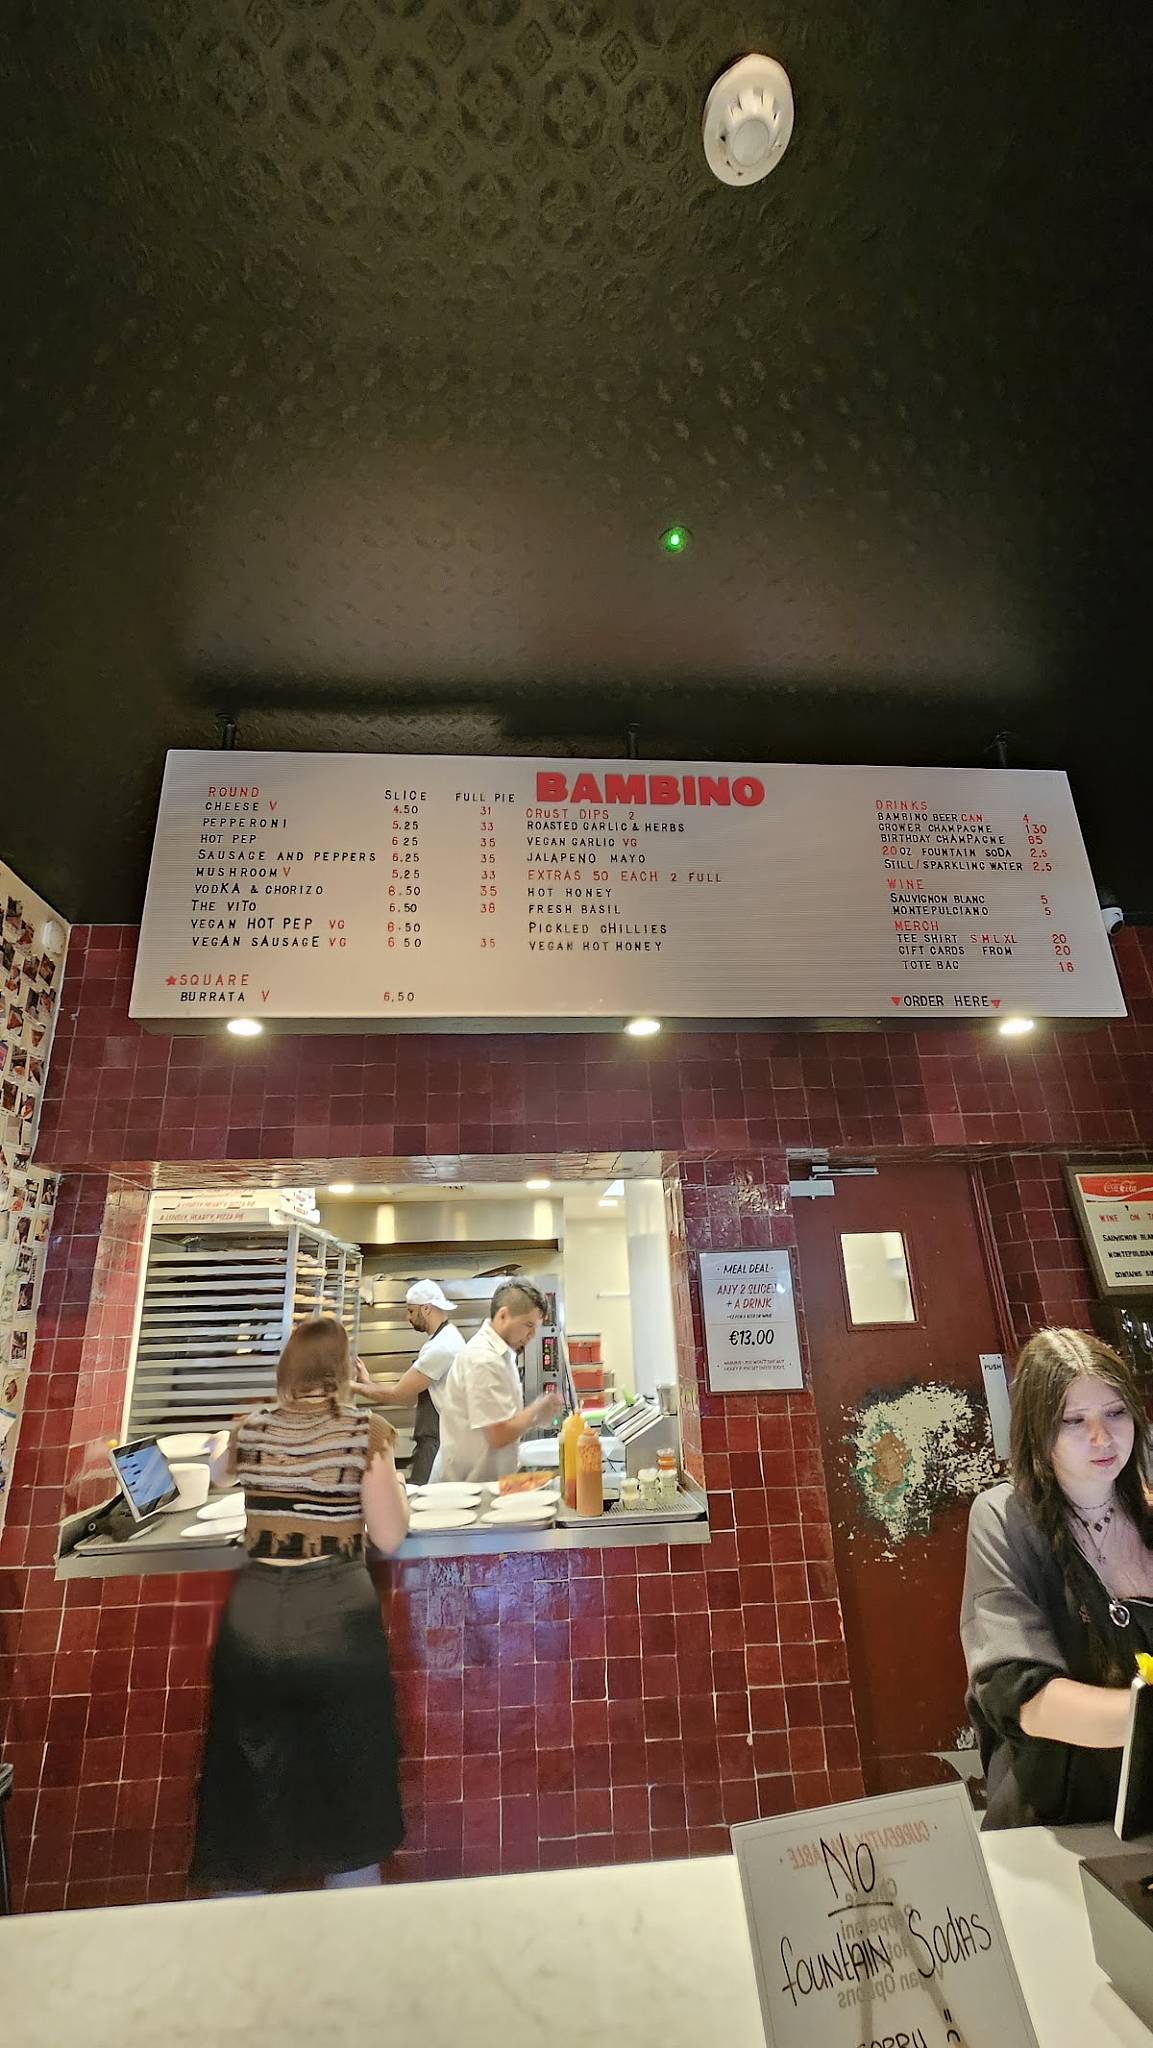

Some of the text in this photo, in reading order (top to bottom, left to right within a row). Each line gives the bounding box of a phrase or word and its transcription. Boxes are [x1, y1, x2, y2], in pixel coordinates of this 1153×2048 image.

[208, 786, 260, 798] ROUND
[536, 771, 765, 807] BAMBINO
[384, 790, 427, 801] SLICE
[455, 792, 515, 803] FULL PIE
[205, 800, 278, 812] CHEESE V
[392, 805, 419, 815] 4.50
[876, 800, 927, 810] DRINKS
[480, 806, 492, 816] 31
[579, 809, 609, 820] DIPS
[629, 811, 635, 820] 2
[202, 817, 288, 828] PEPPERONI
[877, 813, 983, 822] BAMBINO BEER CAN
[392, 820, 419, 831] 5.25
[480, 822, 494, 832] 33
[527, 821, 685, 832] ROASTED GARLIC & HERBS
[879, 824, 992, 833] GROWER CHAMPAGNE
[1026, 824, 1047, 834] 130
[200, 834, 257, 845] HOT PEP
[480, 838, 496, 848] 35
[527, 837, 637, 847] VEGAN GARLIC VG
[881, 834, 930, 843] BIRTHDAY
[198, 850, 376, 862] SAUSAGE AND PEPPERS
[392, 852, 419, 863] 6.25
[922, 848, 976, 857] FOUNTAIN
[1030, 848, 1048, 858] 2.5
[480, 854, 496, 864] 35
[526, 854, 646, 863] JALAPENO MAYO
[990, 861, 1023, 871] WATER
[1033, 862, 1052, 871] 2.5
[196, 867, 291, 878] MUSHROOM V
[392, 869, 420, 879] 5.25
[481, 870, 496, 880] 33
[528, 870, 722, 883] EXTRAS 50 EACH 2 FULL
[888, 879, 925, 890] WINE
[250, 885, 258, 894] &
[265, 885, 324, 895] CHORIZO
[480, 886, 498, 897] 35
[528, 888, 611, 898] HOT HONEY
[891, 893, 985, 904] SAUVIGNON BLANC
[1041, 895, 1048, 904] 5
[389, 902, 418, 913] 6.50
[480, 902, 496, 913] 38
[528, 904, 621, 914] FRESH BASIL
[893, 906, 989, 916] MONTEPULCIANO
[1044, 907, 1051, 916] 5
[191, 917, 345, 930] VEGAN HOT PEP VG
[529, 922, 589, 934] PICKLED
[894, 921, 939, 931] MERCH
[192, 935, 347, 948] VEGAN SAUSAGE VG
[480, 938, 496, 948] 35
[897, 934, 918, 943] TEE
[924, 934, 958, 943] SHIRT
[971, 935, 977, 944] S
[994, 935, 1000, 944] L
[1004, 935, 1018, 944] XL
[1052, 934, 1067, 944] 20
[529, 941, 662, 951] VEGAN HOT HONEY
[898, 945, 1013, 956] GIFT CARDS FROM
[1055, 946, 1071, 956] 20
[903, 960, 959, 970] TOTE BAG
[179, 974, 250, 986] SQUARE
[180, 990, 270, 1003] BURRATA V
[383, 991, 415, 1002] 6.50
[904, 995, 990, 1007] ORDER HERE
[1099, 1214, 1119, 1223] WINE
[723, 1264, 769, 1274] MEAL DEAL
[717, 1284, 738, 1295] ANY
[740, 1284, 746, 1294] 2
[734, 1299, 742, 1309] A
[743, 1298, 772, 1309] DRINK
[729, 1329, 774, 1346] €13.00
